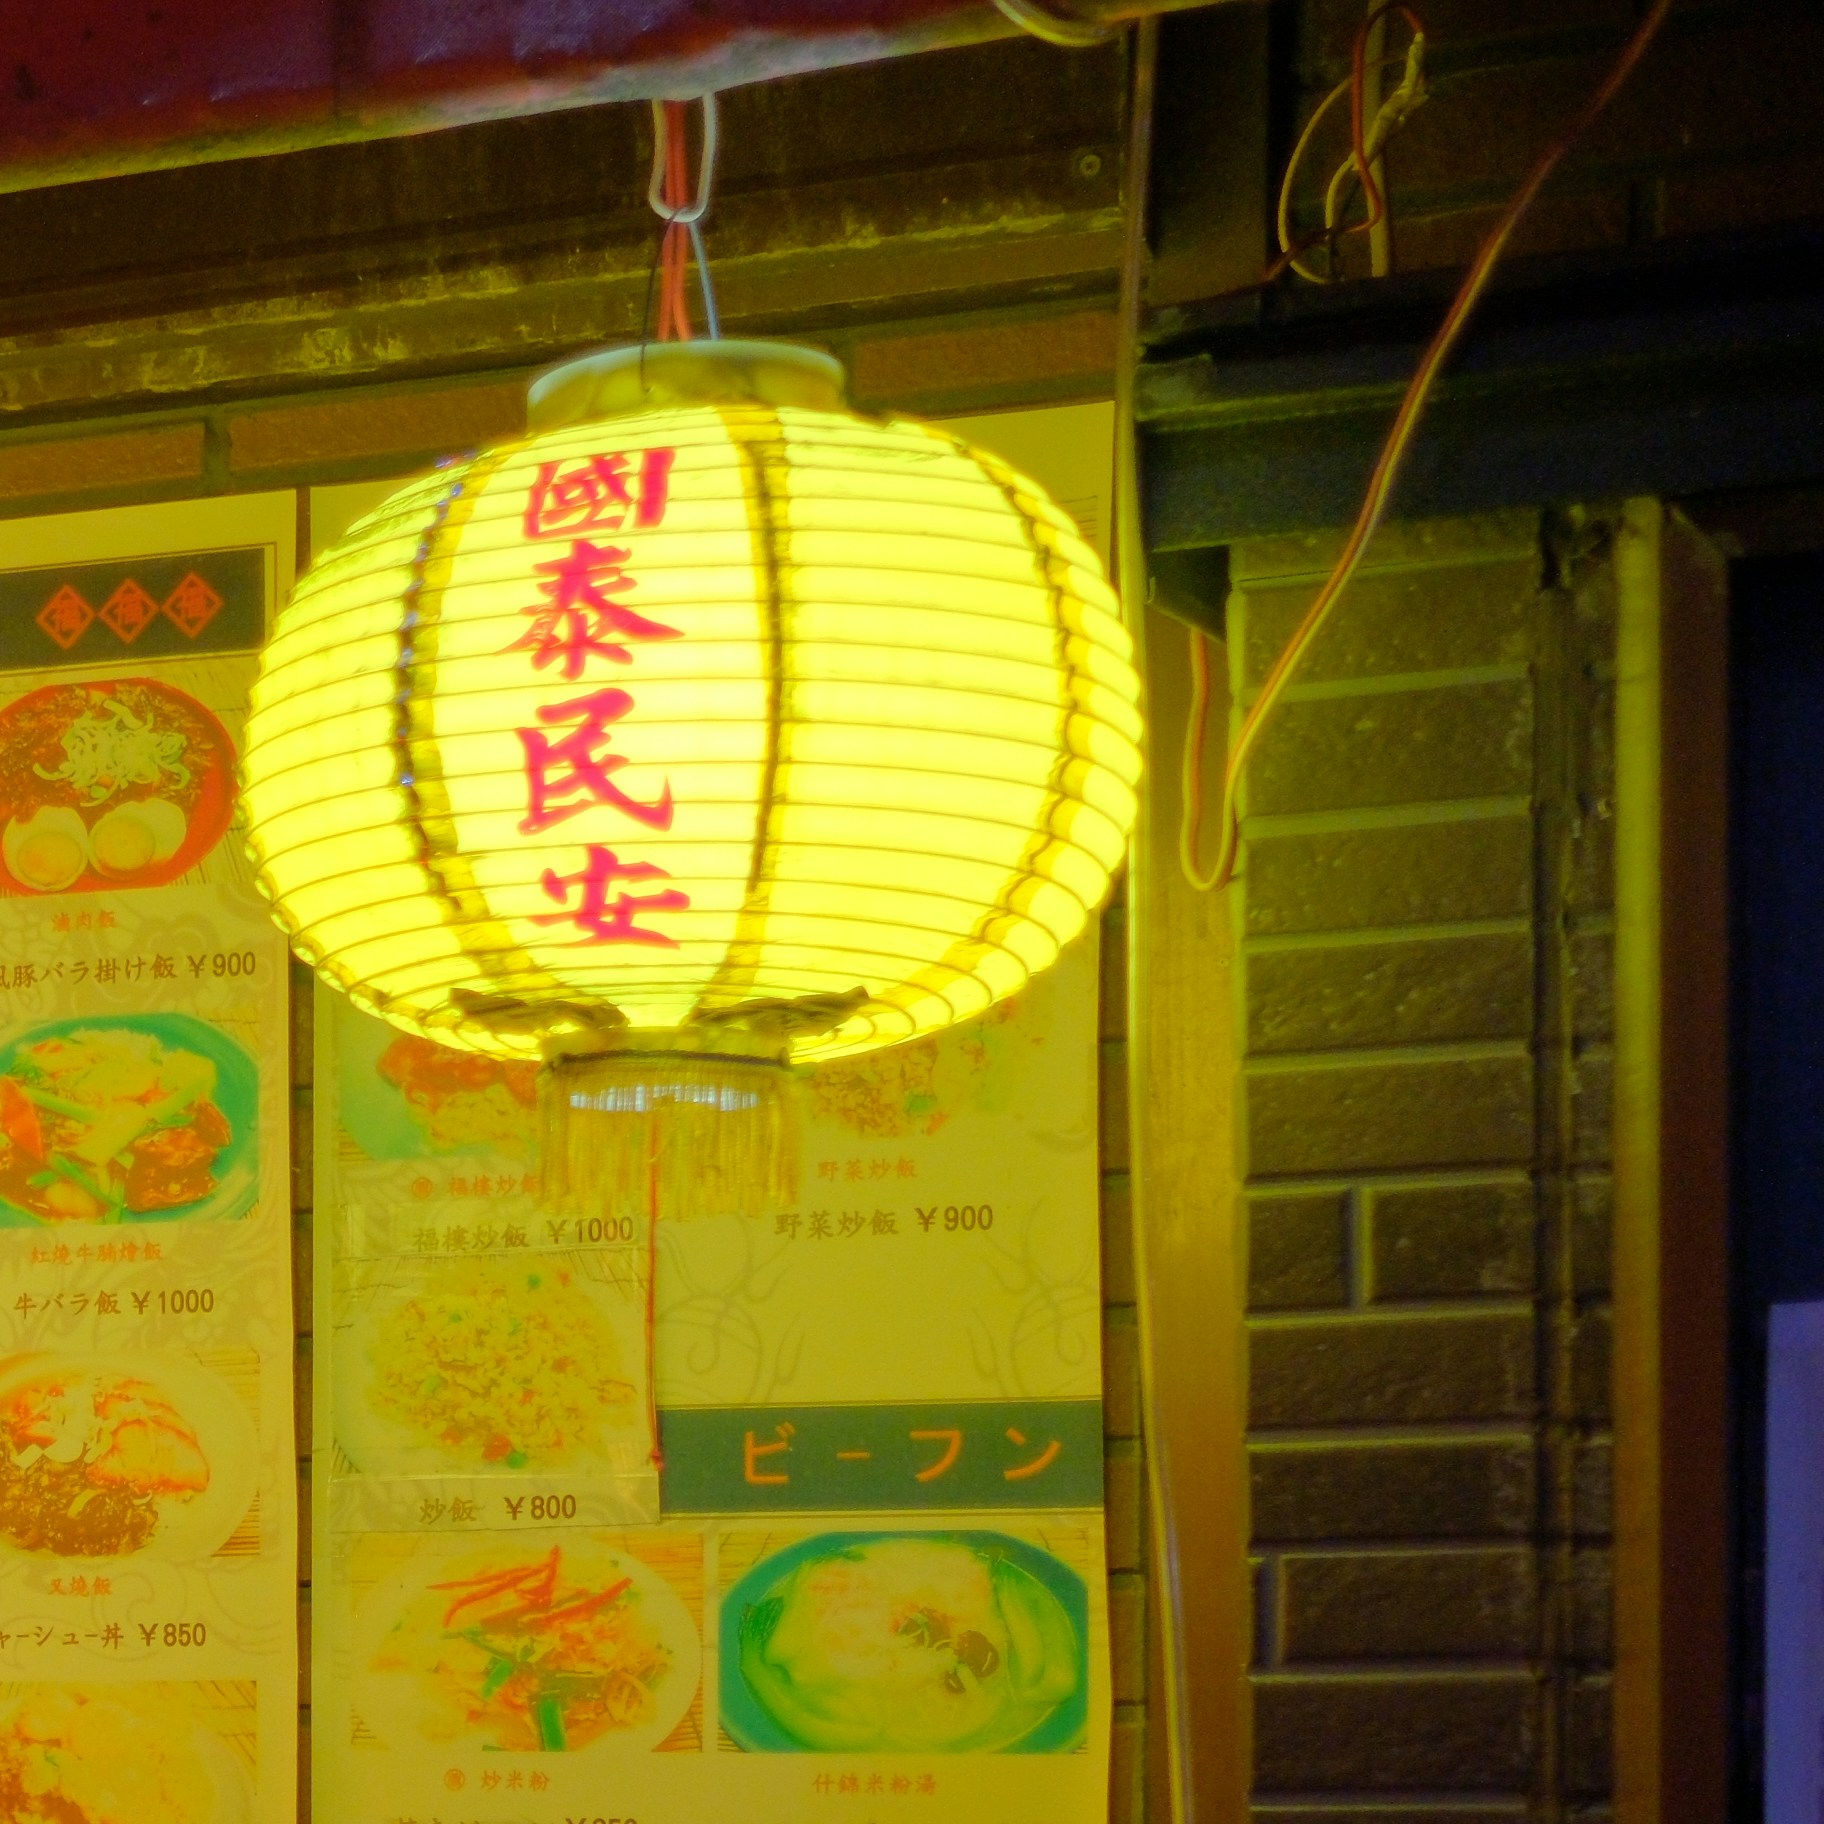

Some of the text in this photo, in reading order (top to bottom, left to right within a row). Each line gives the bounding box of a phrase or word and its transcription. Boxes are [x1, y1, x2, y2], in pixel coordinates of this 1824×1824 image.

[507, 446, 690, 950] 國泰民安
[186, 951, 257, 981] ¥900
[816, 1156, 920, 1183] 野菜炒飯
[546, 1215, 634, 1244] ¥1000
[773, 1204, 995, 1239] 野菜炒飯 ¥900
[12, 1288, 215, 1319] 牛バラ飯 ¥1000
[742, 1421, 1062, 1488] ビーフン
[419, 1494, 577, 1524] 炒飯 ¥800
[139, 1622, 207, 1648] ¥850
[480, 1769, 551, 1792] 炒米粉
